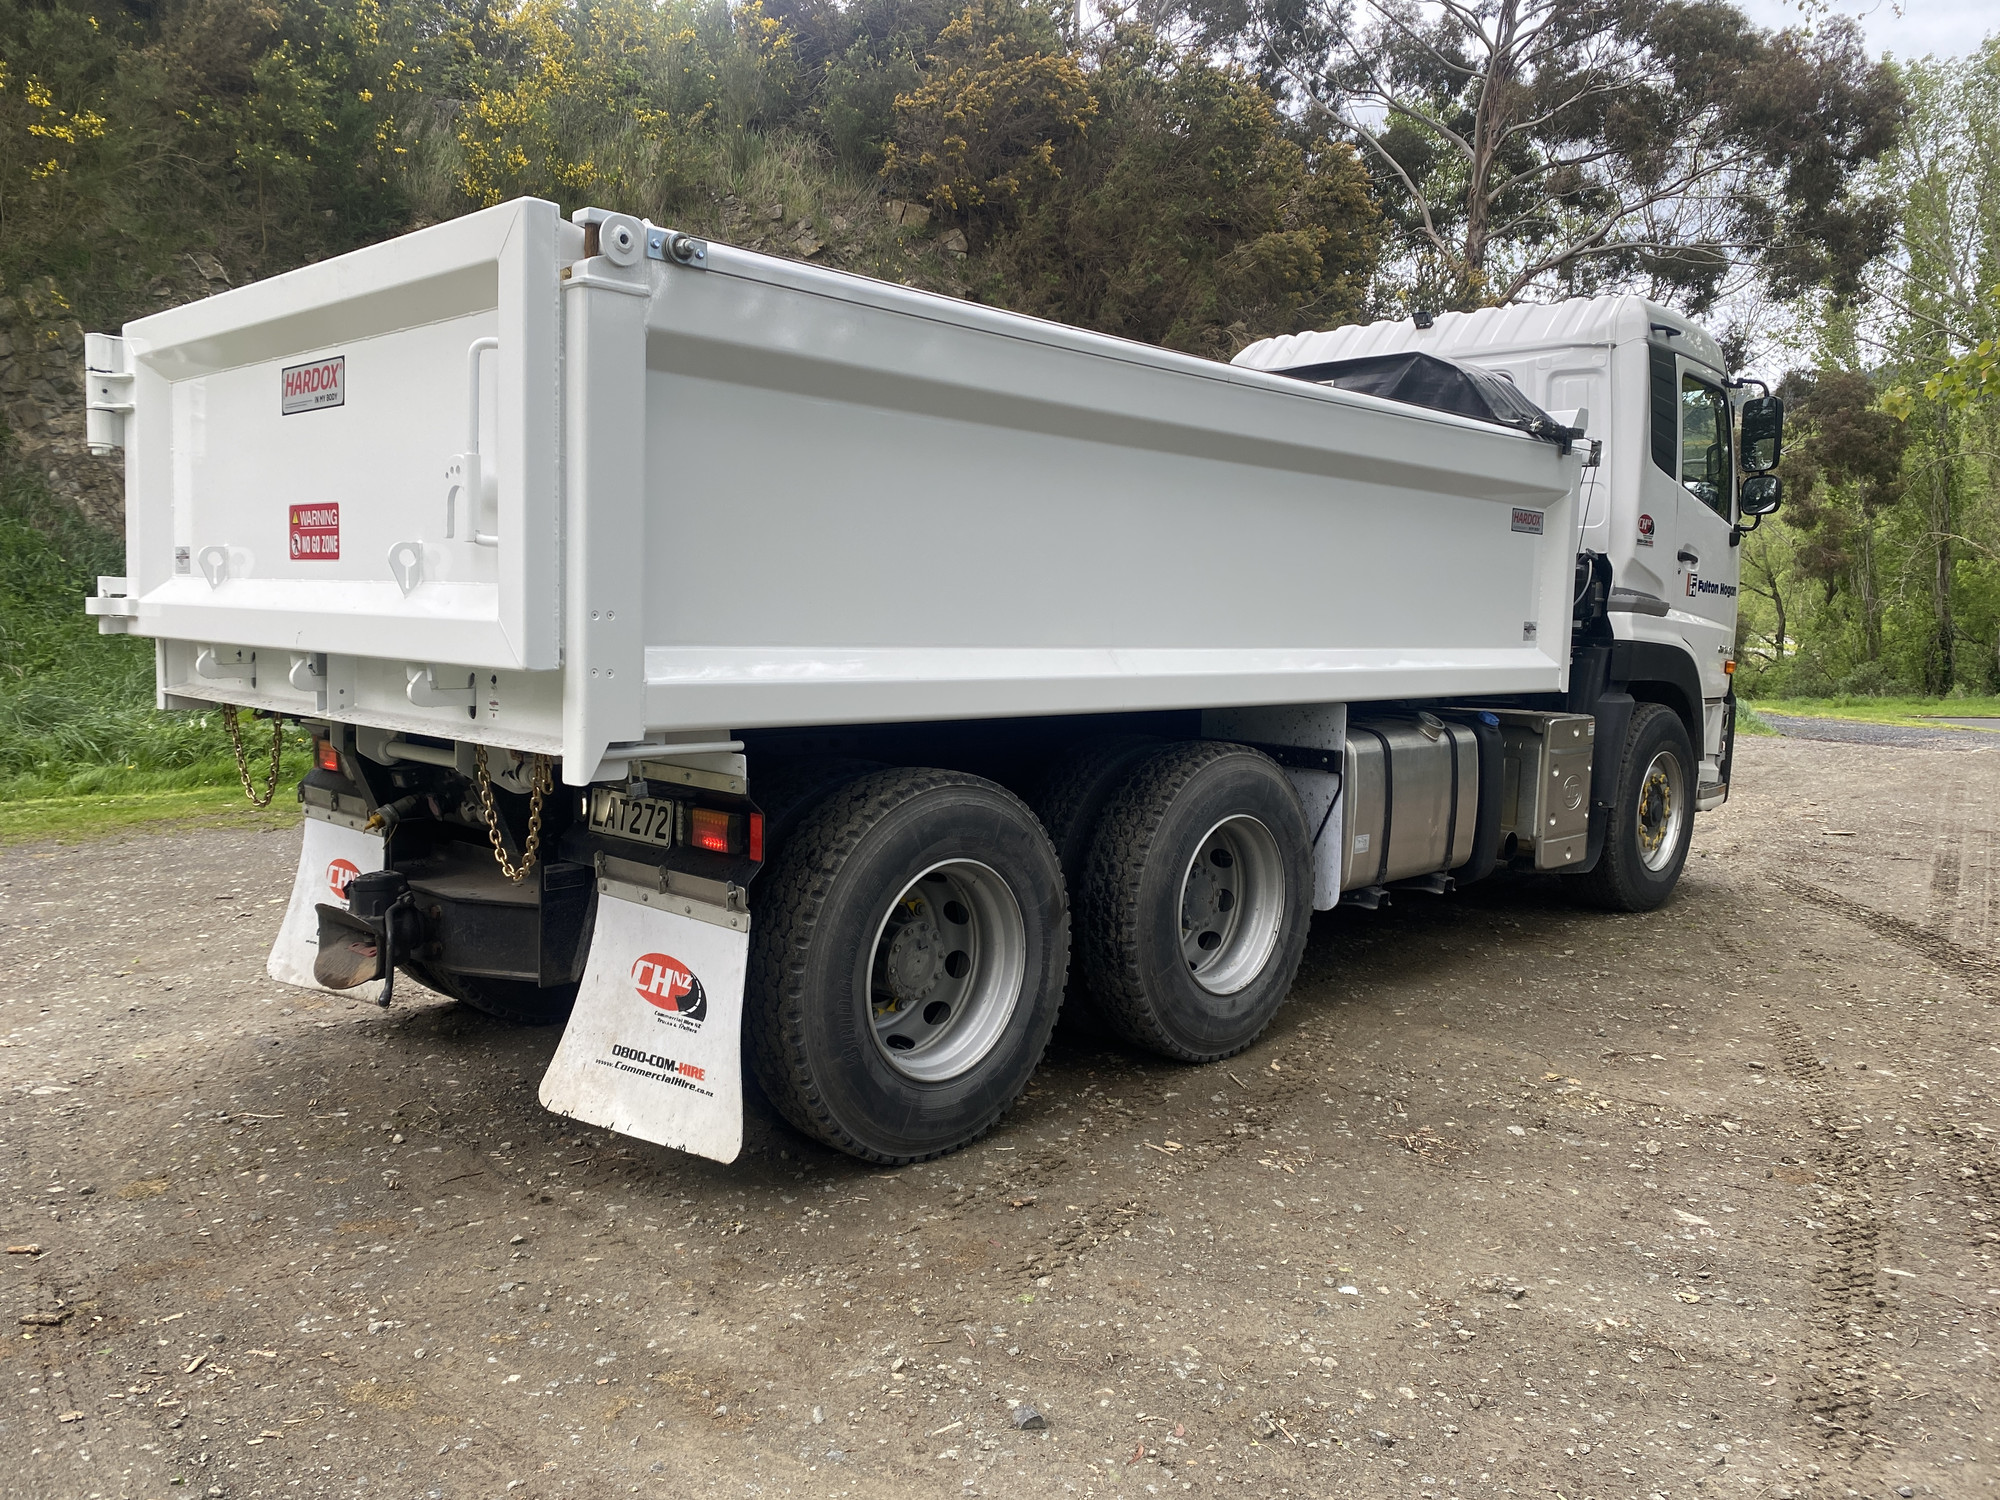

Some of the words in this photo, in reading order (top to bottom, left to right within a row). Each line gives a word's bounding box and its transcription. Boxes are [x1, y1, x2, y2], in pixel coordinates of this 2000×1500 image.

[285, 363, 339, 397] HARDOX
[326, 392, 338, 401] BODY
[300, 509, 338, 526] WARNING
[1514, 511, 1540, 526] HARDOX
[302, 535, 310, 553] NO
[311, 535, 320, 553] GO
[321, 535, 338, 553] ZONE
[1698, 580, 1719, 595] Fulton
[1720, 582, 1737, 598] Hogan
[592, 794, 669, 840] LAT272
[612, 1044, 706, 1081] 0800-COM-HIRE
[595, 1058, 714, 1097] www.CommercialHire.co.nz
